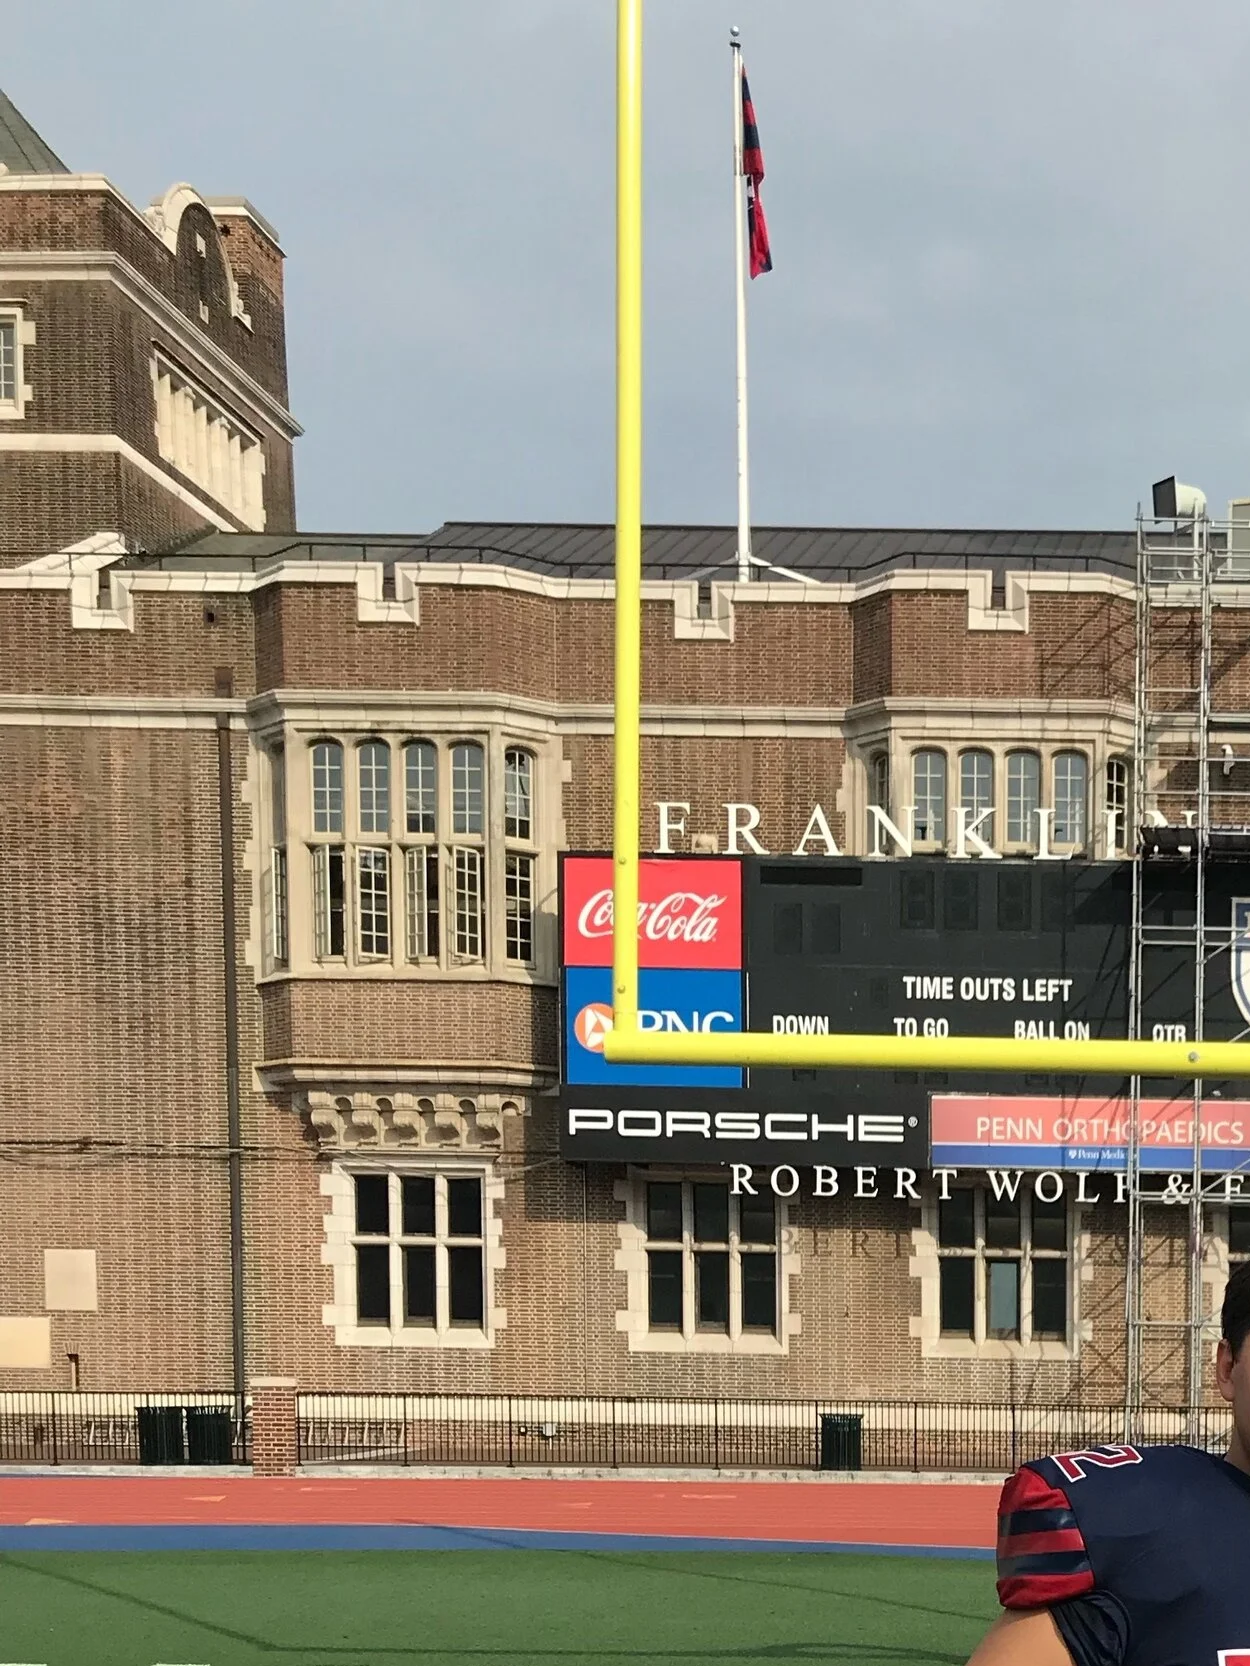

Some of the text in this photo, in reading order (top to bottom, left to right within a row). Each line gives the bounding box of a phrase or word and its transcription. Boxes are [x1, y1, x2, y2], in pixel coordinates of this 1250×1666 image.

[578, 889, 728, 943] Coa-Cola
[902, 976, 1073, 1002] TIME OUTS LEFT
[637, 1010, 735, 1034] PNC
[772, 1014, 829, 1036] DOWN
[893, 1017, 950, 1039] TO GO
[1014, 1019, 1090, 1041] BALL ON
[976, 1116, 1244, 1145] PENN ORTHOPAEDICS
[730, 1163, 958, 1200] ROBERT
[1161, 1173, 1196, 1205] &
